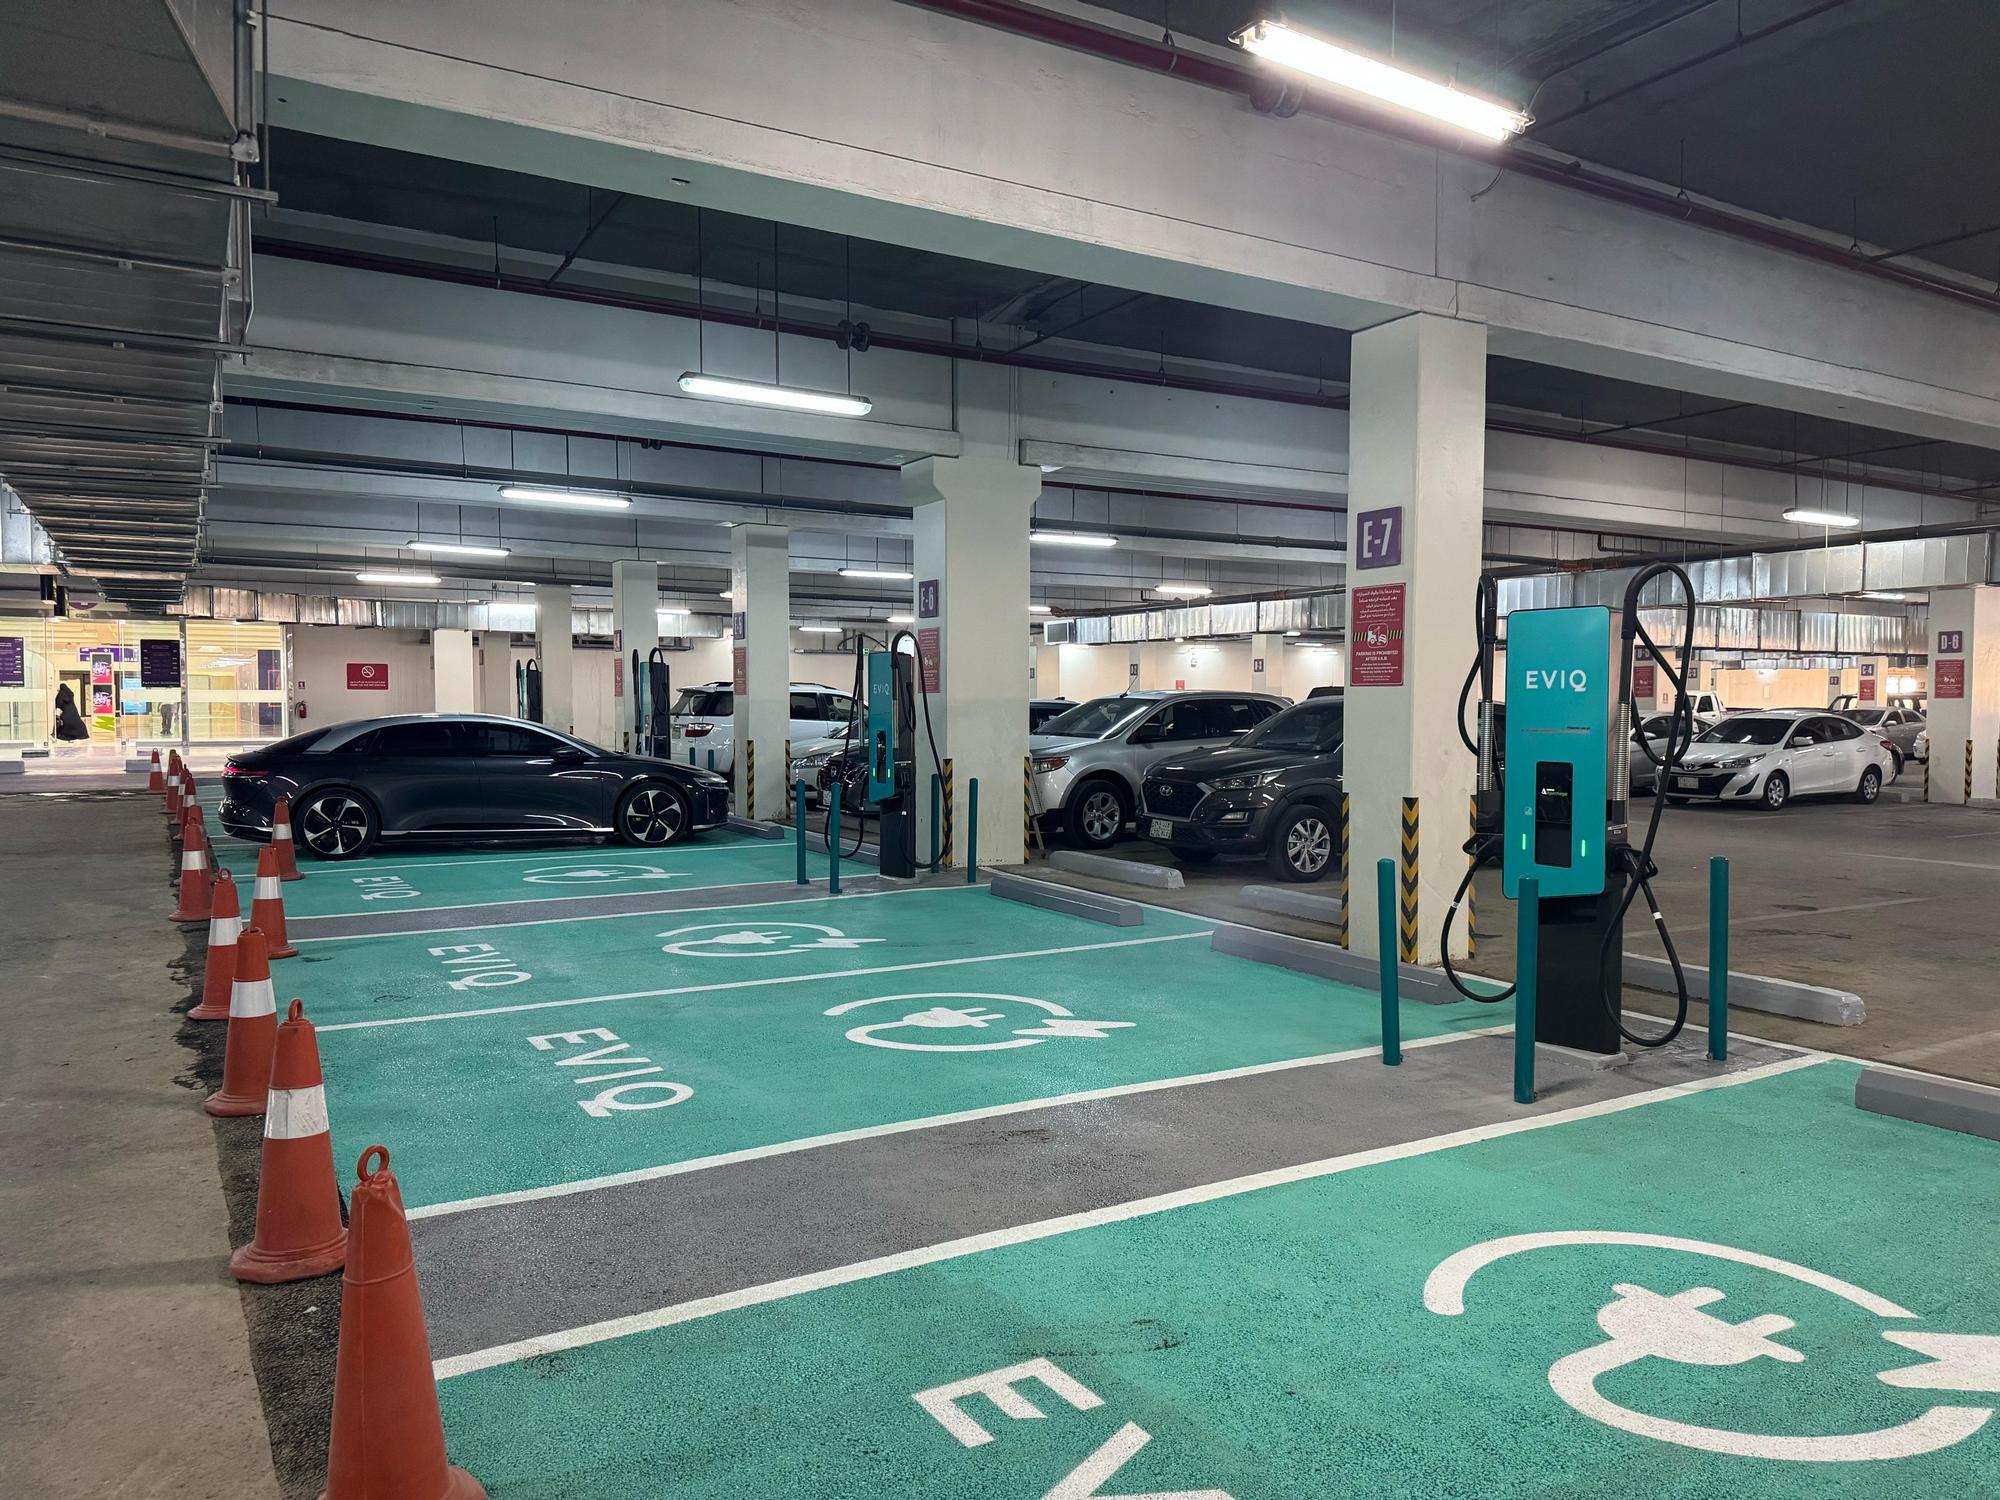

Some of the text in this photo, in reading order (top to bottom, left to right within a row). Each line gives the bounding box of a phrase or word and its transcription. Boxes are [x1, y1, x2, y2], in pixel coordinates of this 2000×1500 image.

[1362, 517, 1393, 559] E-7
[920, 586, 934, 611] E-6
[1941, 634, 1959, 650] D-6
[873, 683, 890, 695] EVIQ
[1526, 669, 1587, 692] EVIQ
[352, 875, 422, 900] EVIQ
[428, 943, 532, 990] EVIQ
[526, 1027, 694, 1118] EVIQ
